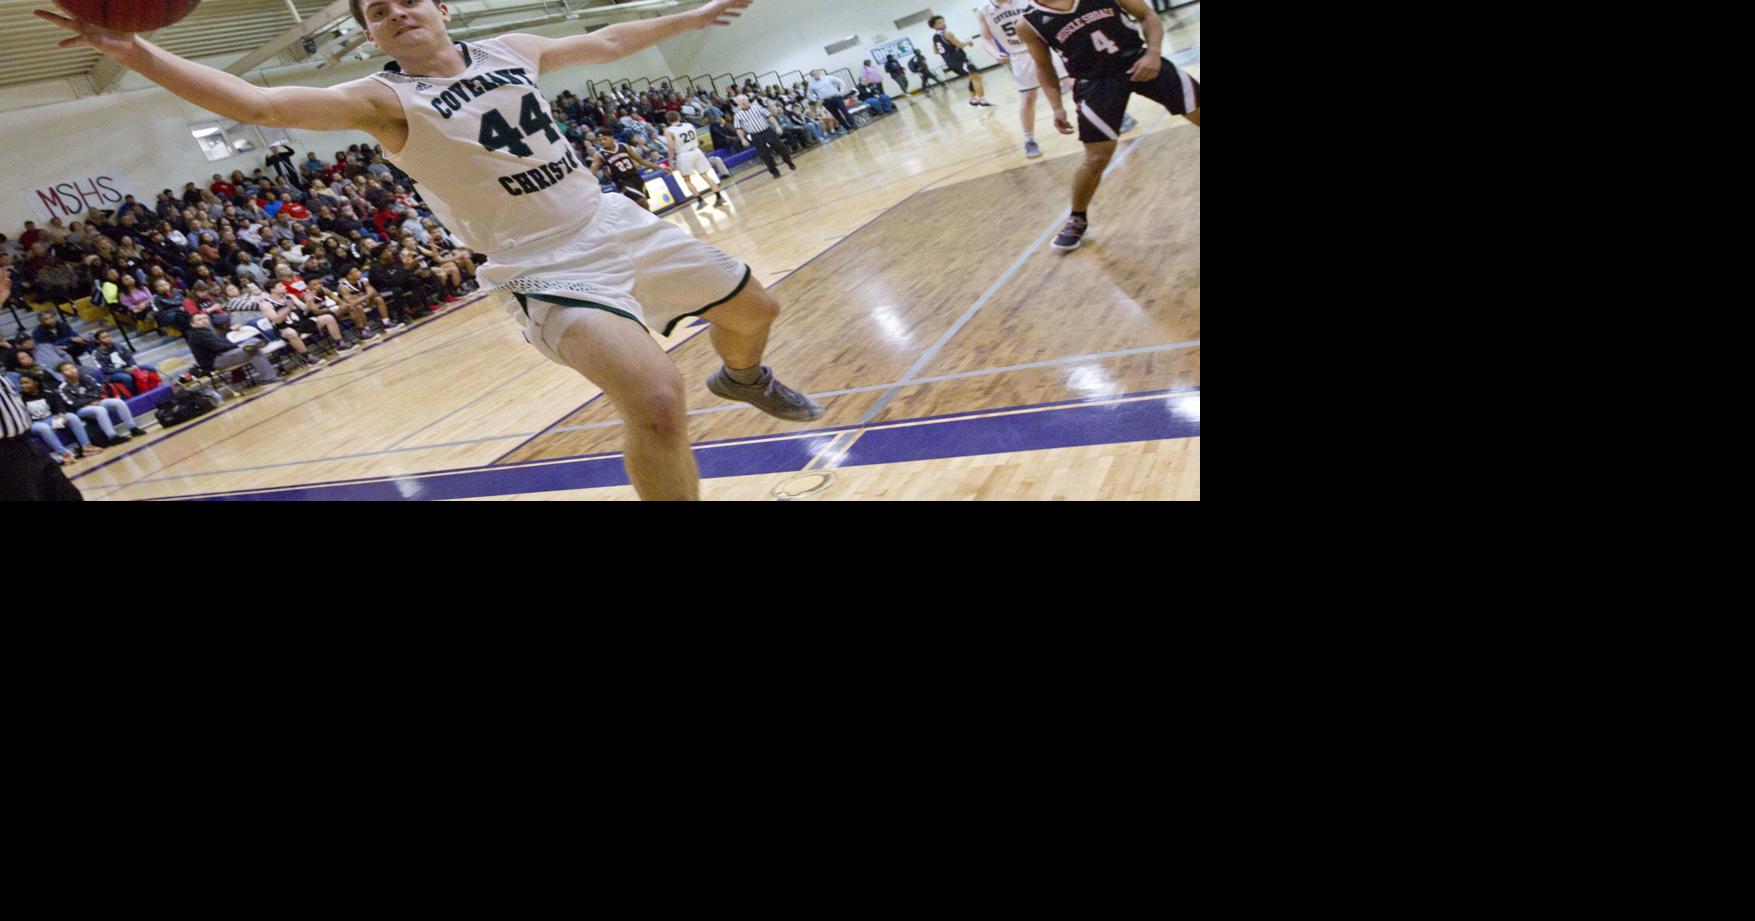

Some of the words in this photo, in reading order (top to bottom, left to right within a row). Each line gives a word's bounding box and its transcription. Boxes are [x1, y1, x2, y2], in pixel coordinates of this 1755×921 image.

[1001, 20, 1018, 36] 5
[1055, 18, 1084, 43] MUSCLE
[1081, 8, 1114, 24] SHOALS
[1090, 30, 1119, 54] 4
[479, 92, 560, 157] 44
[680, 130, 695, 143] 20
[498, 145, 578, 196] CHRISTI
[615, 158, 633, 171] 23
[36, 176, 122, 218] MSHS
